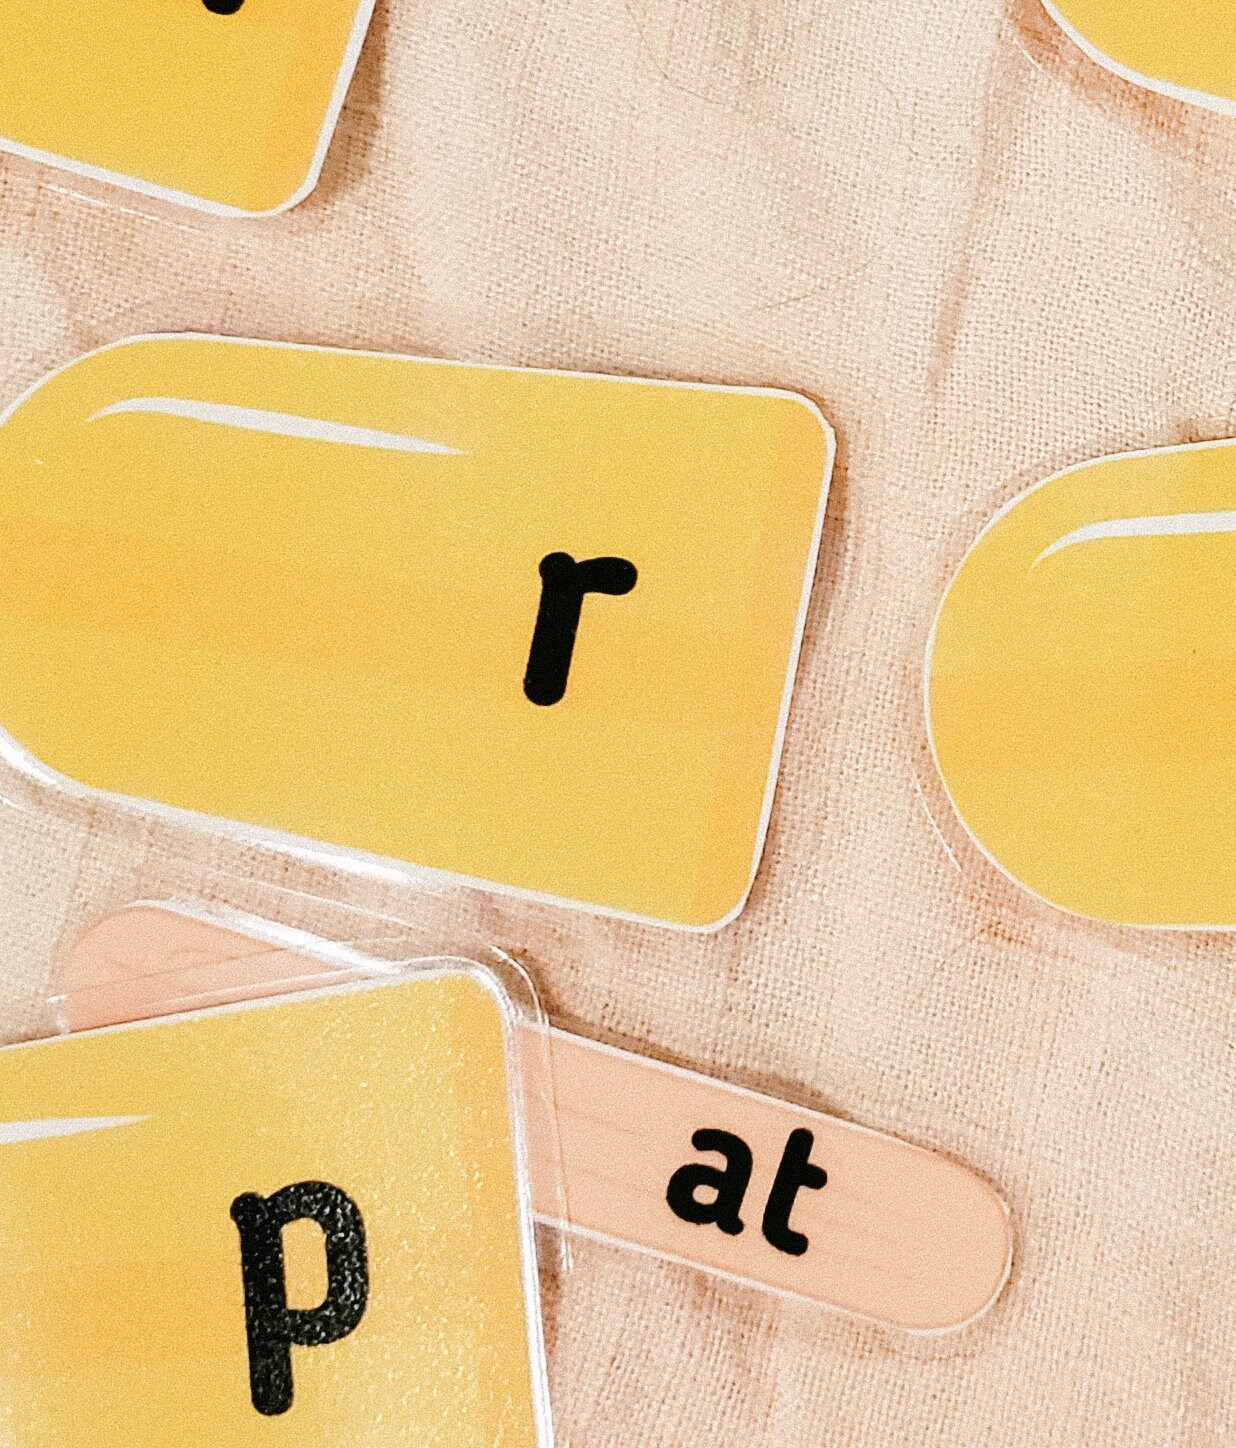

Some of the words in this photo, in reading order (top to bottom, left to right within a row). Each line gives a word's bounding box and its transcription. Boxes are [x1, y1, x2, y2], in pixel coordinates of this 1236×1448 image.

[523, 551, 638, 707] r
[665, 1128, 828, 1257] at
[229, 1180, 369, 1417] p
